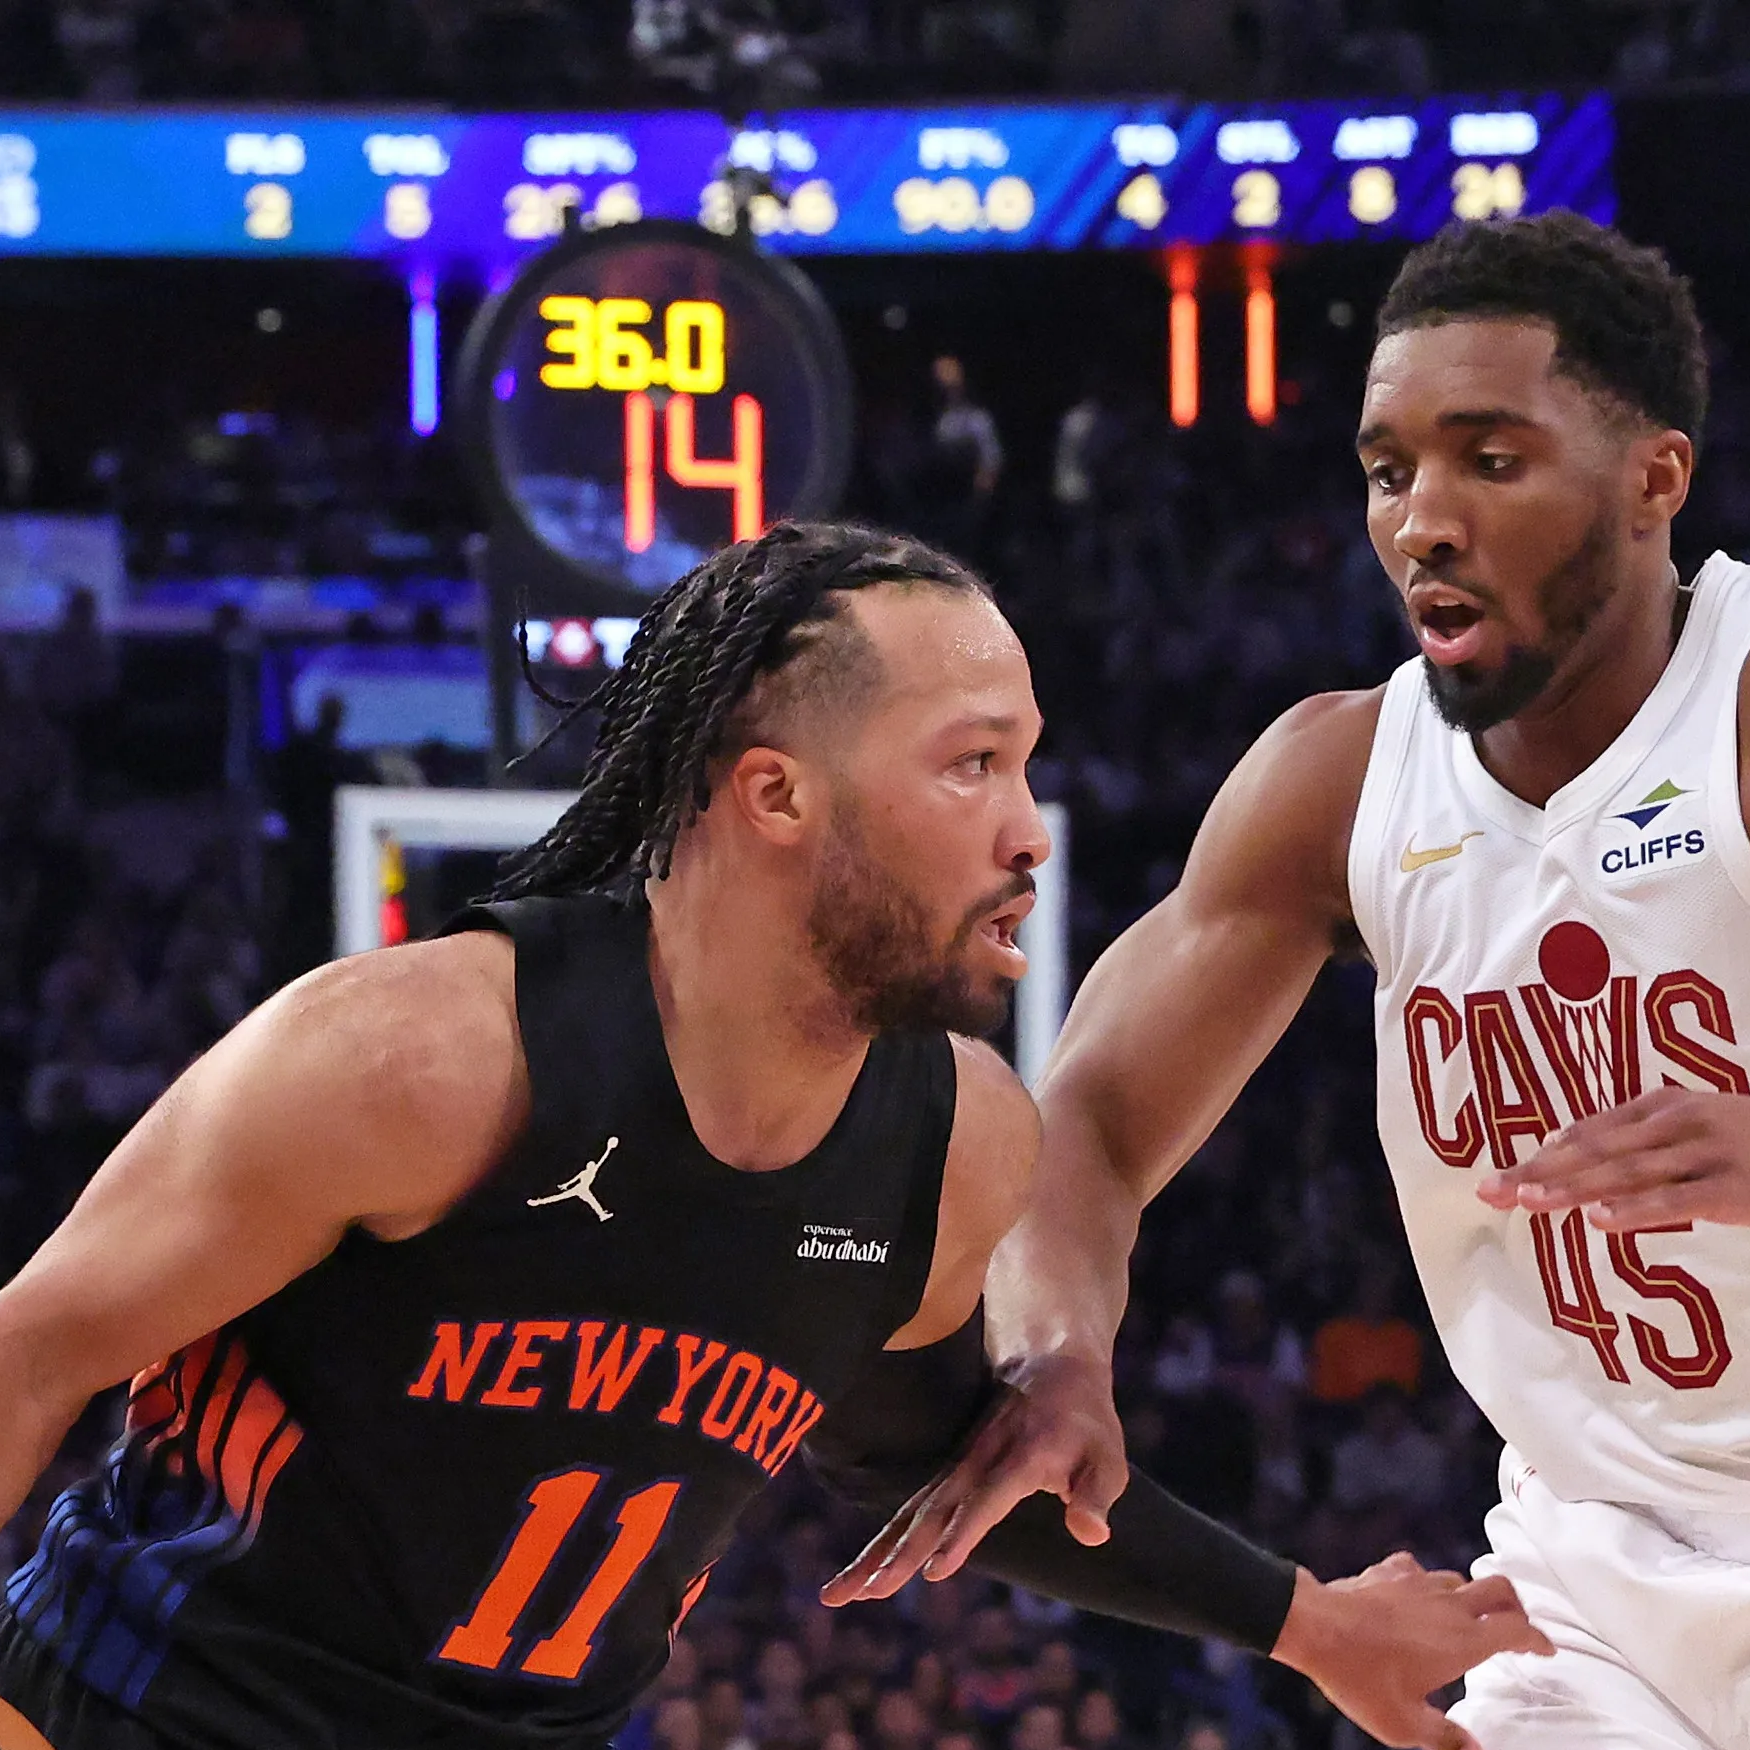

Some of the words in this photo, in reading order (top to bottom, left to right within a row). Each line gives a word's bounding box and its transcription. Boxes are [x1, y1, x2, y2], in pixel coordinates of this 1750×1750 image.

[540, 295, 726, 393] 36.0
[623, 391, 764, 554] 14
[1601, 829, 1706, 875] CLIFFS
[803, 1224, 854, 1236] experience
[1530, 1208, 1734, 1390] 45
[406, 1317, 664, 1413] NEW
[657, 1331, 827, 1479] YORK
[434, 1466, 682, 1681] 11
